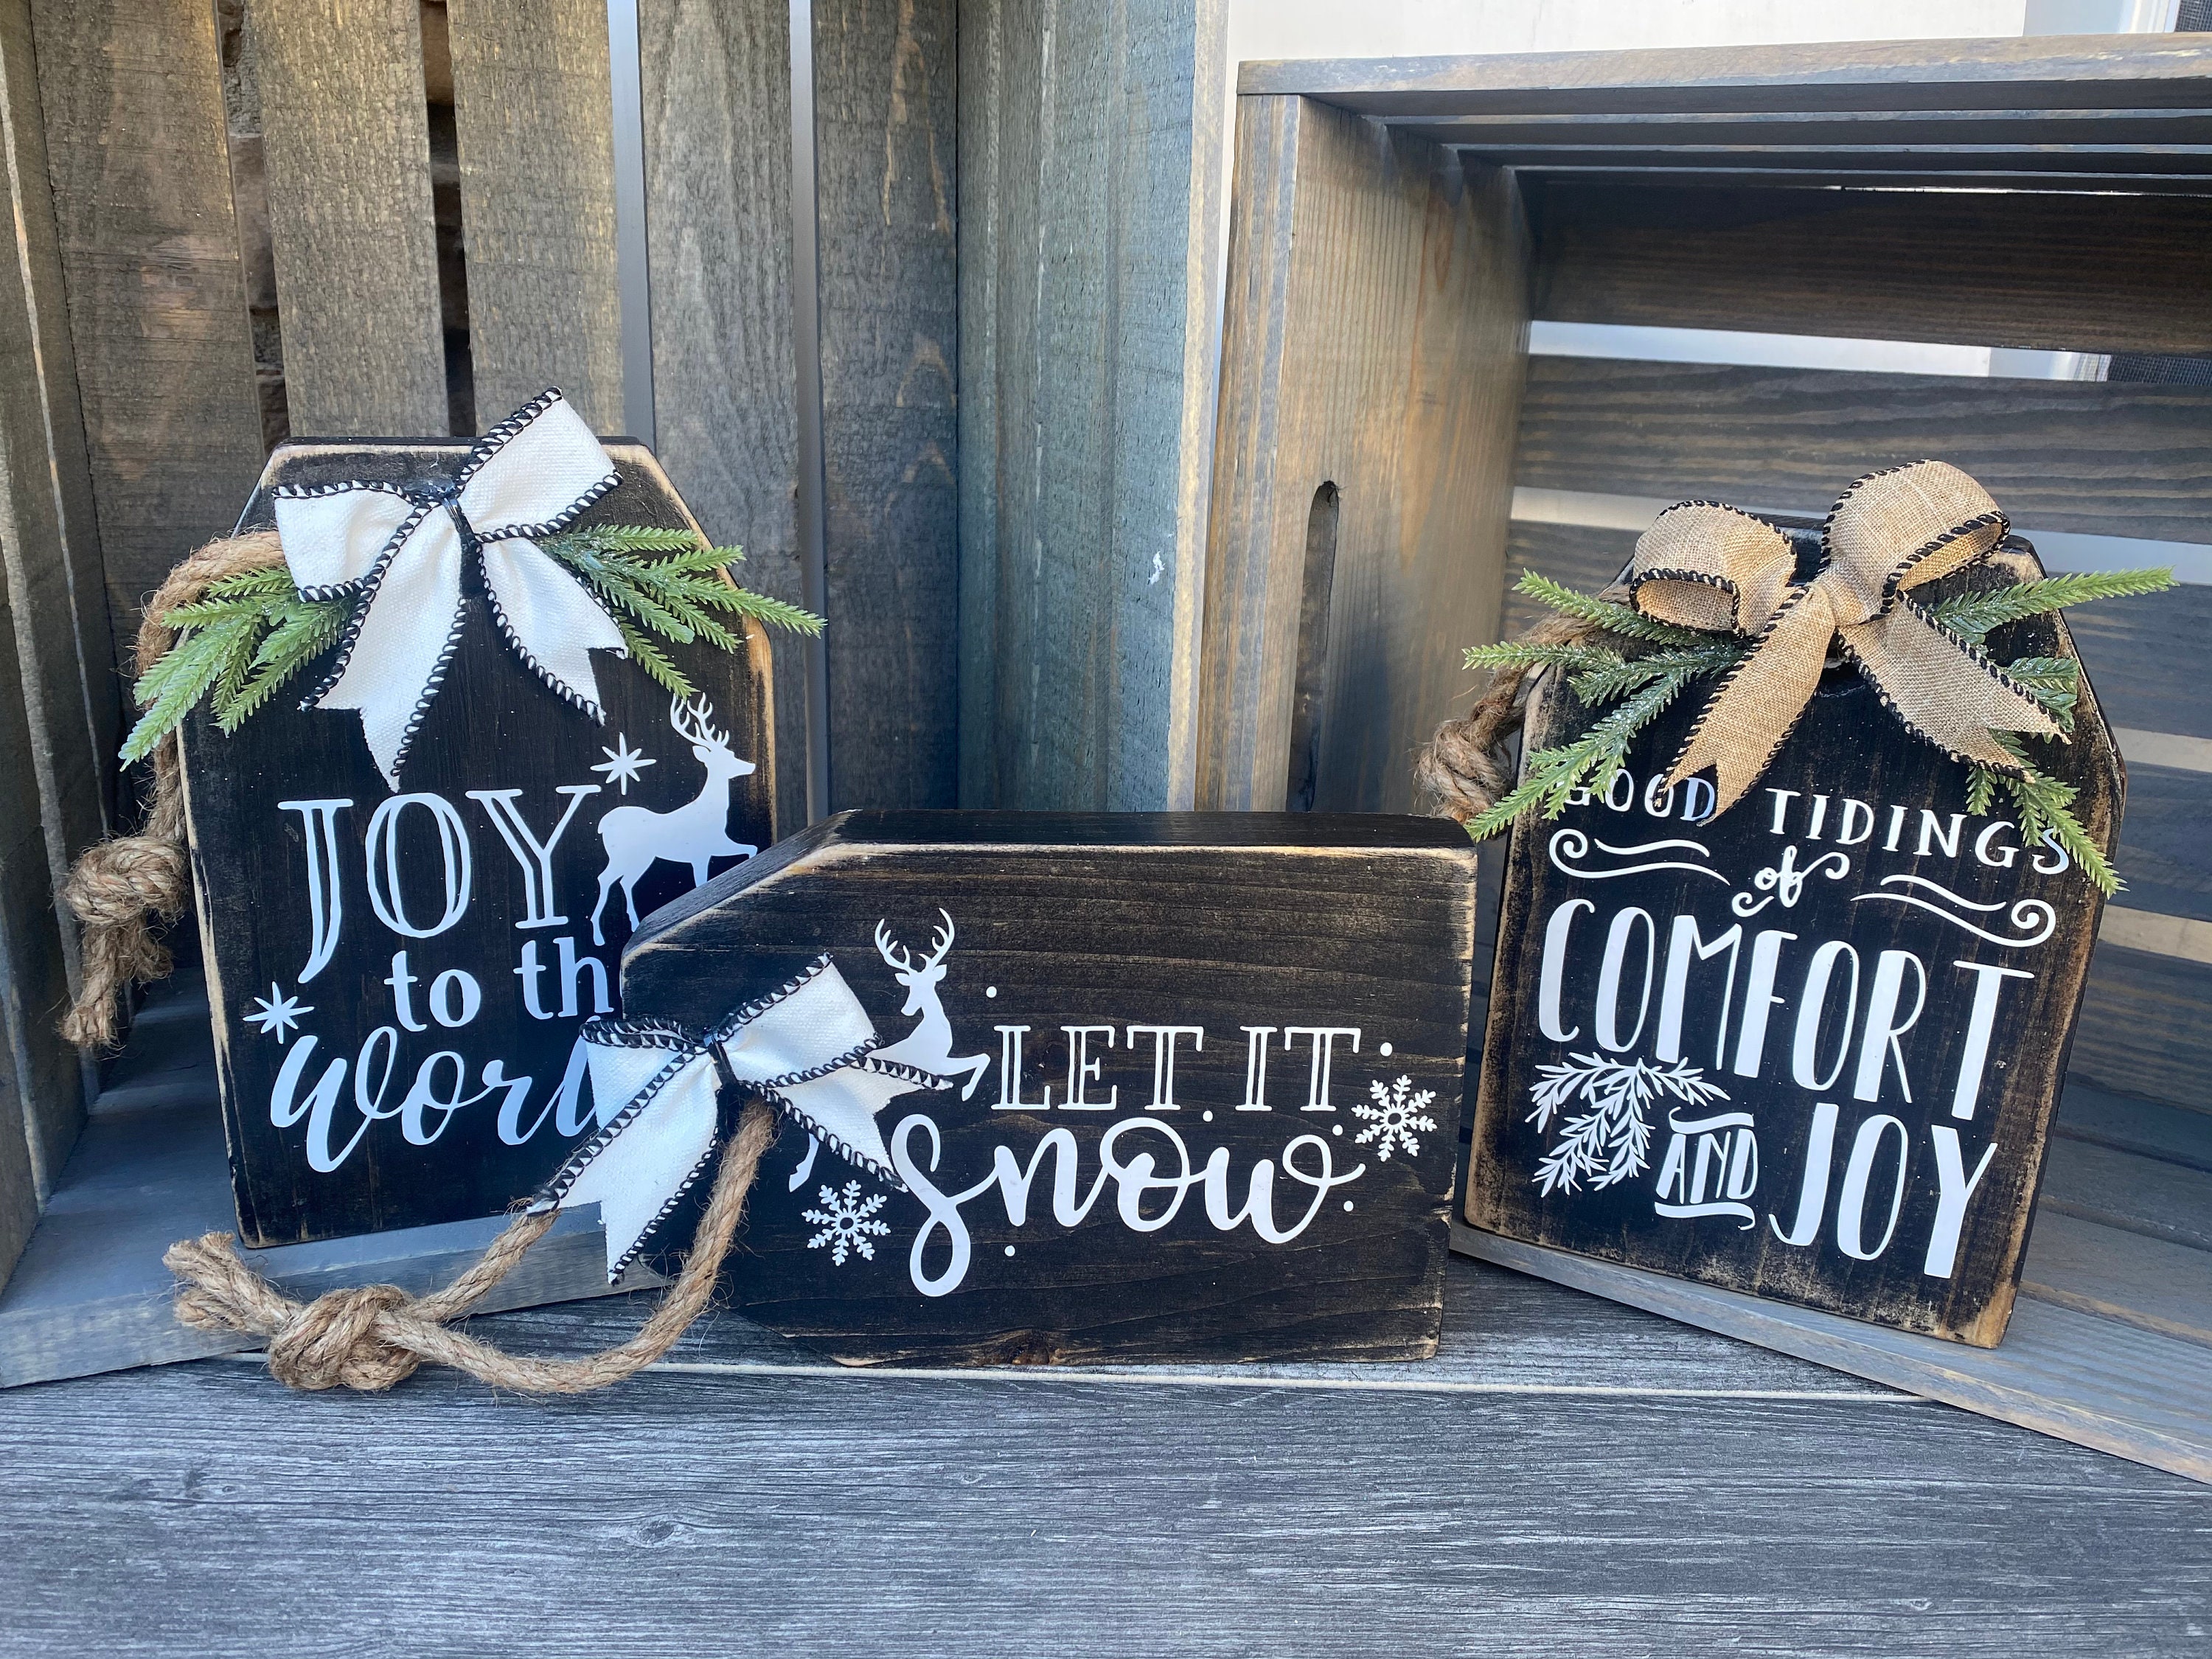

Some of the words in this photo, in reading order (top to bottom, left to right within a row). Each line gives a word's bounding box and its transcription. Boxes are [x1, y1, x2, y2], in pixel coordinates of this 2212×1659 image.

[277, 783, 602, 984] JOY
[1753, 844, 1851, 908] of
[1764, 787, 2070, 876] TIDINGS
[383, 949, 481, 1032] to
[512, 936, 622, 1020] th
[1538, 898, 2035, 1121] COMFORT
[270, 1015, 596, 1174] Worl
[990, 1024, 1204, 1111] LET
[1234, 1025, 1362, 1112] IT
[1655, 1128, 1759, 1205] AND
[1768, 1102, 1999, 1279] JOY
